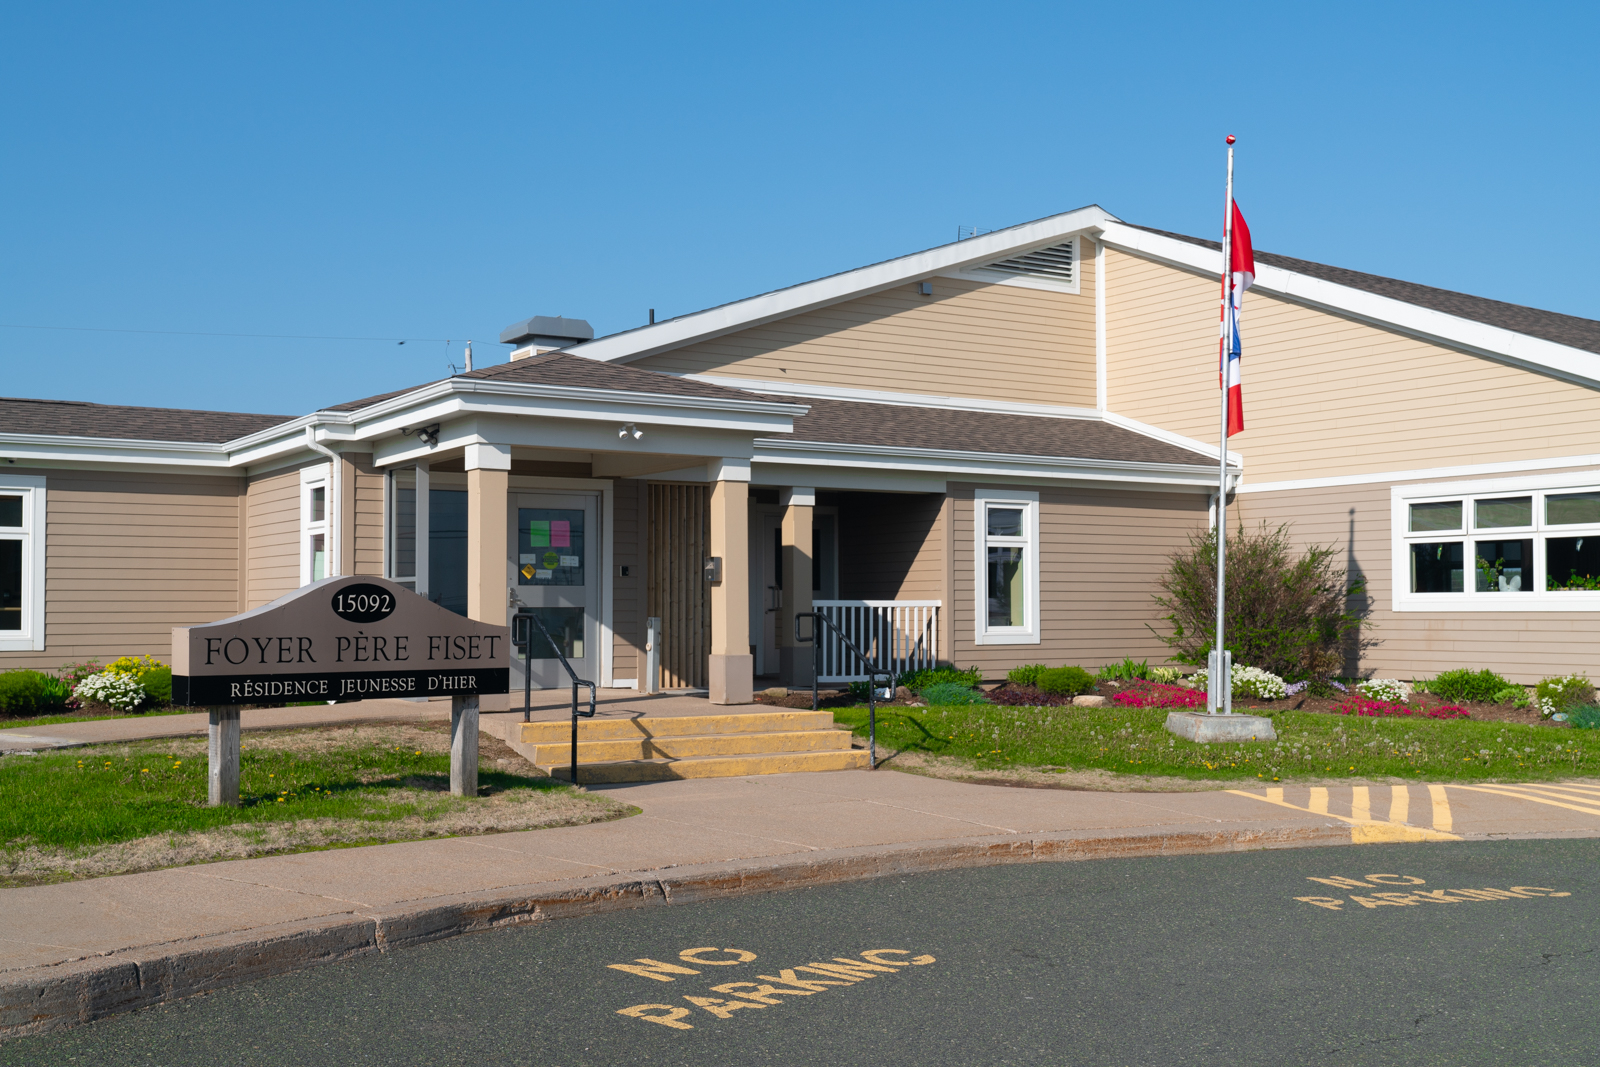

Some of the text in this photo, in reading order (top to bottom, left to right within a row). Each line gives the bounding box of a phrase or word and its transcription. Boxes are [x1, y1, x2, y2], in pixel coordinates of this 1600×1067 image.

[337, 594, 391, 613] 15092
[204, 630, 502, 666] FOYER PÈRE FISET
[230, 675, 478, 697] RÉSIDENCE JEUNESSE D'HIER
[1306, 873, 1426, 890] NO
[1292, 887, 1572, 910] PARKING
[606, 946, 758, 982] NO
[615, 948, 936, 1030] PARKING
